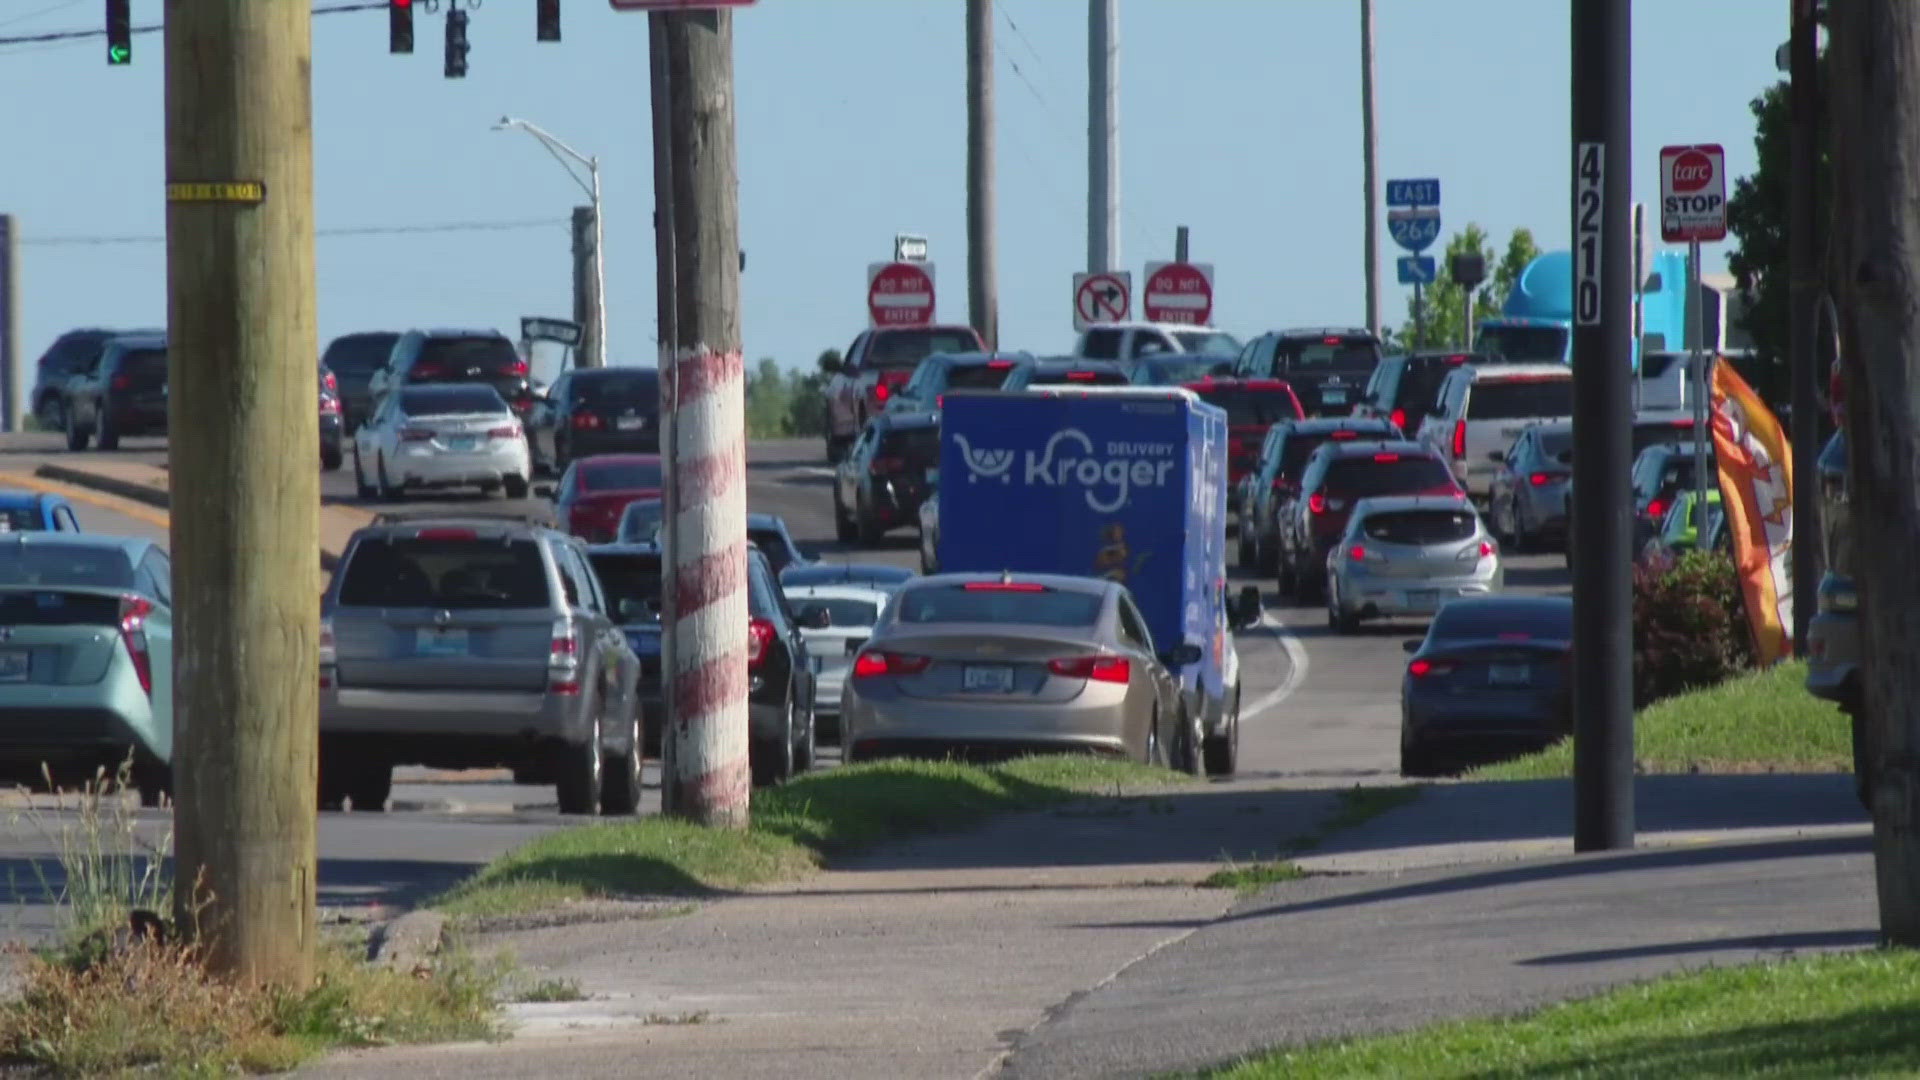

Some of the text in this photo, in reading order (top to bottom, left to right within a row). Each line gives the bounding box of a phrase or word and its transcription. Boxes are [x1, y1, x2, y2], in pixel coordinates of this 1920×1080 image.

[1673, 162, 1709, 181] tarc
[1393, 183, 1434, 201] EAST
[1665, 195, 1722, 214] STOP
[1394, 219, 1436, 243] 264
[1579, 145, 1601, 322] 4210
[879, 278, 924, 290] DO NOT
[1156, 278, 1201, 290] DO NOT
[885, 311, 919, 322] ENTER
[1158, 311, 1195, 323] ENTER
[1106, 442, 1175, 456] DELIVERY
[1024, 428, 1175, 513] Kroger
